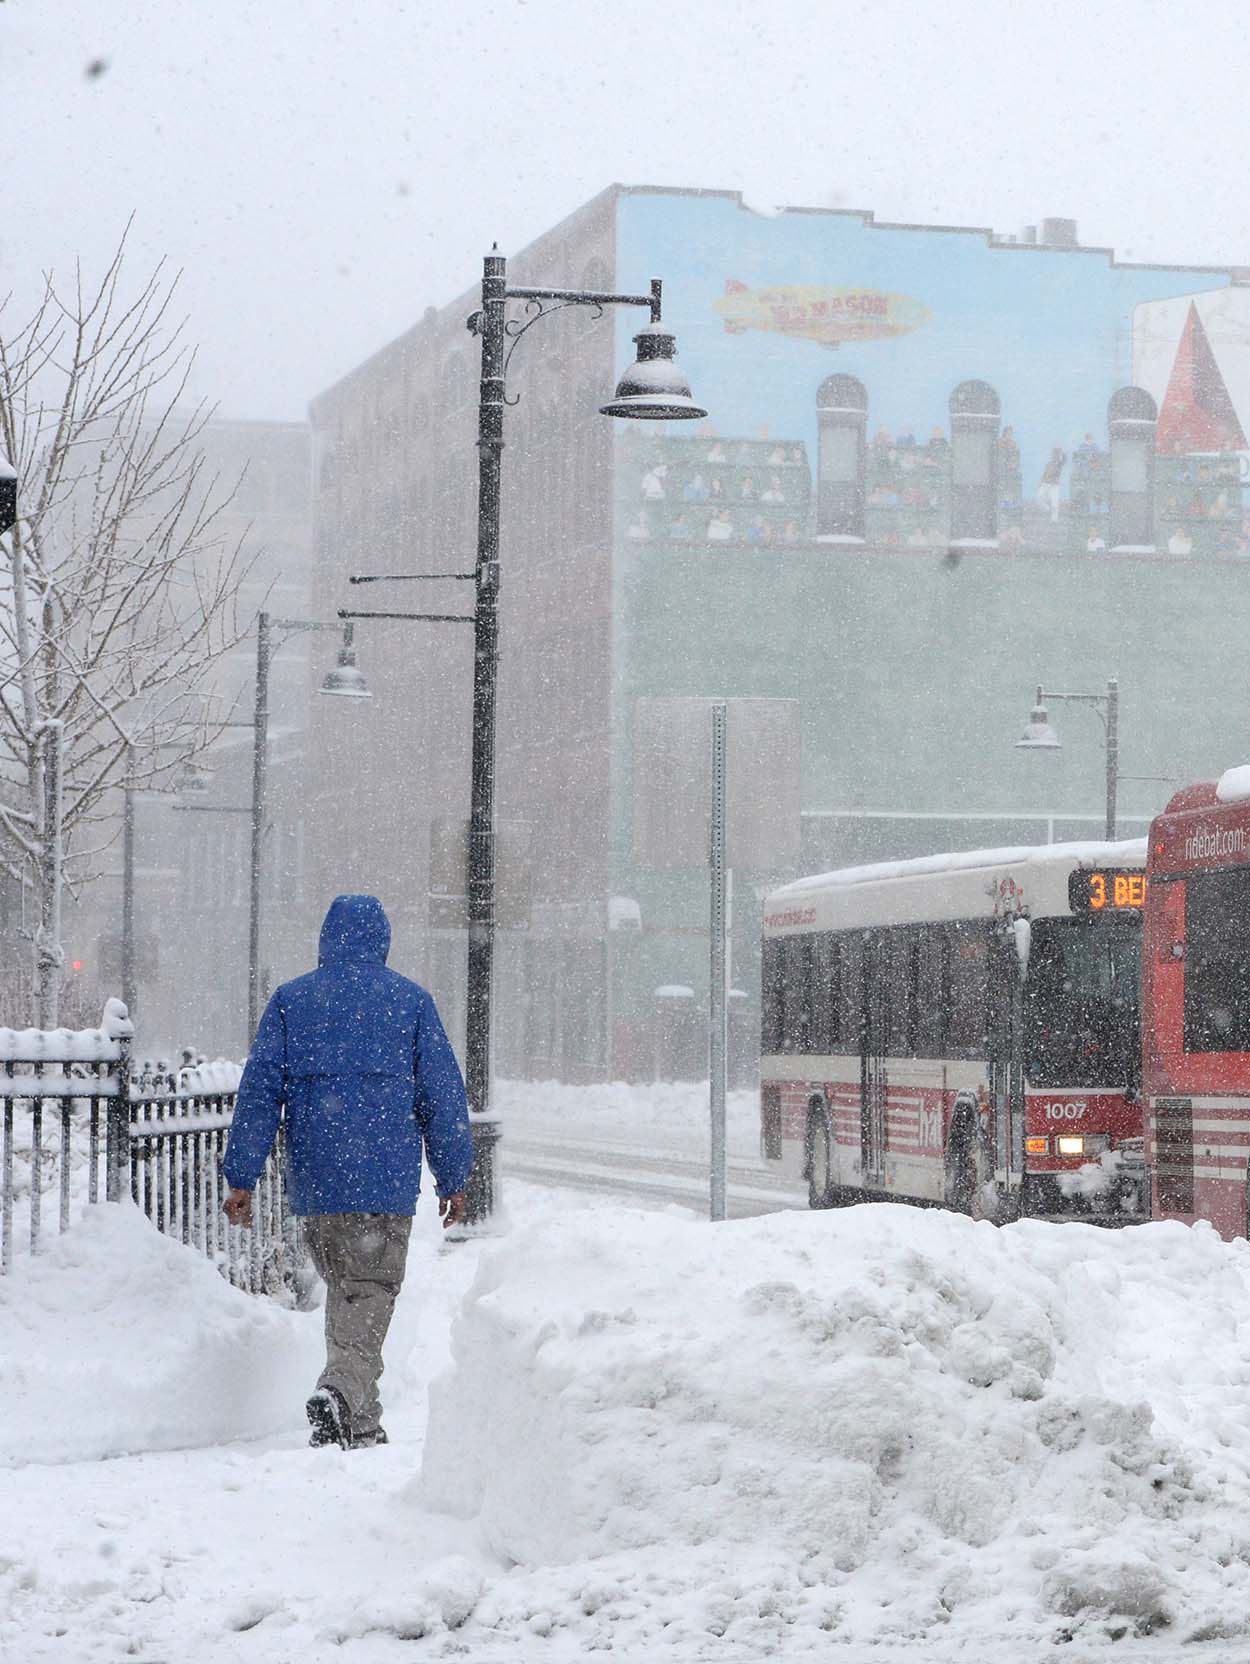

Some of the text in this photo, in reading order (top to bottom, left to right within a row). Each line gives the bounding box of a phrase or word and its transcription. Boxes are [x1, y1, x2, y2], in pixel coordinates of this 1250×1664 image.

[1090, 873, 1146, 909] 3 BE
[1045, 1103, 1086, 1119] 1007
